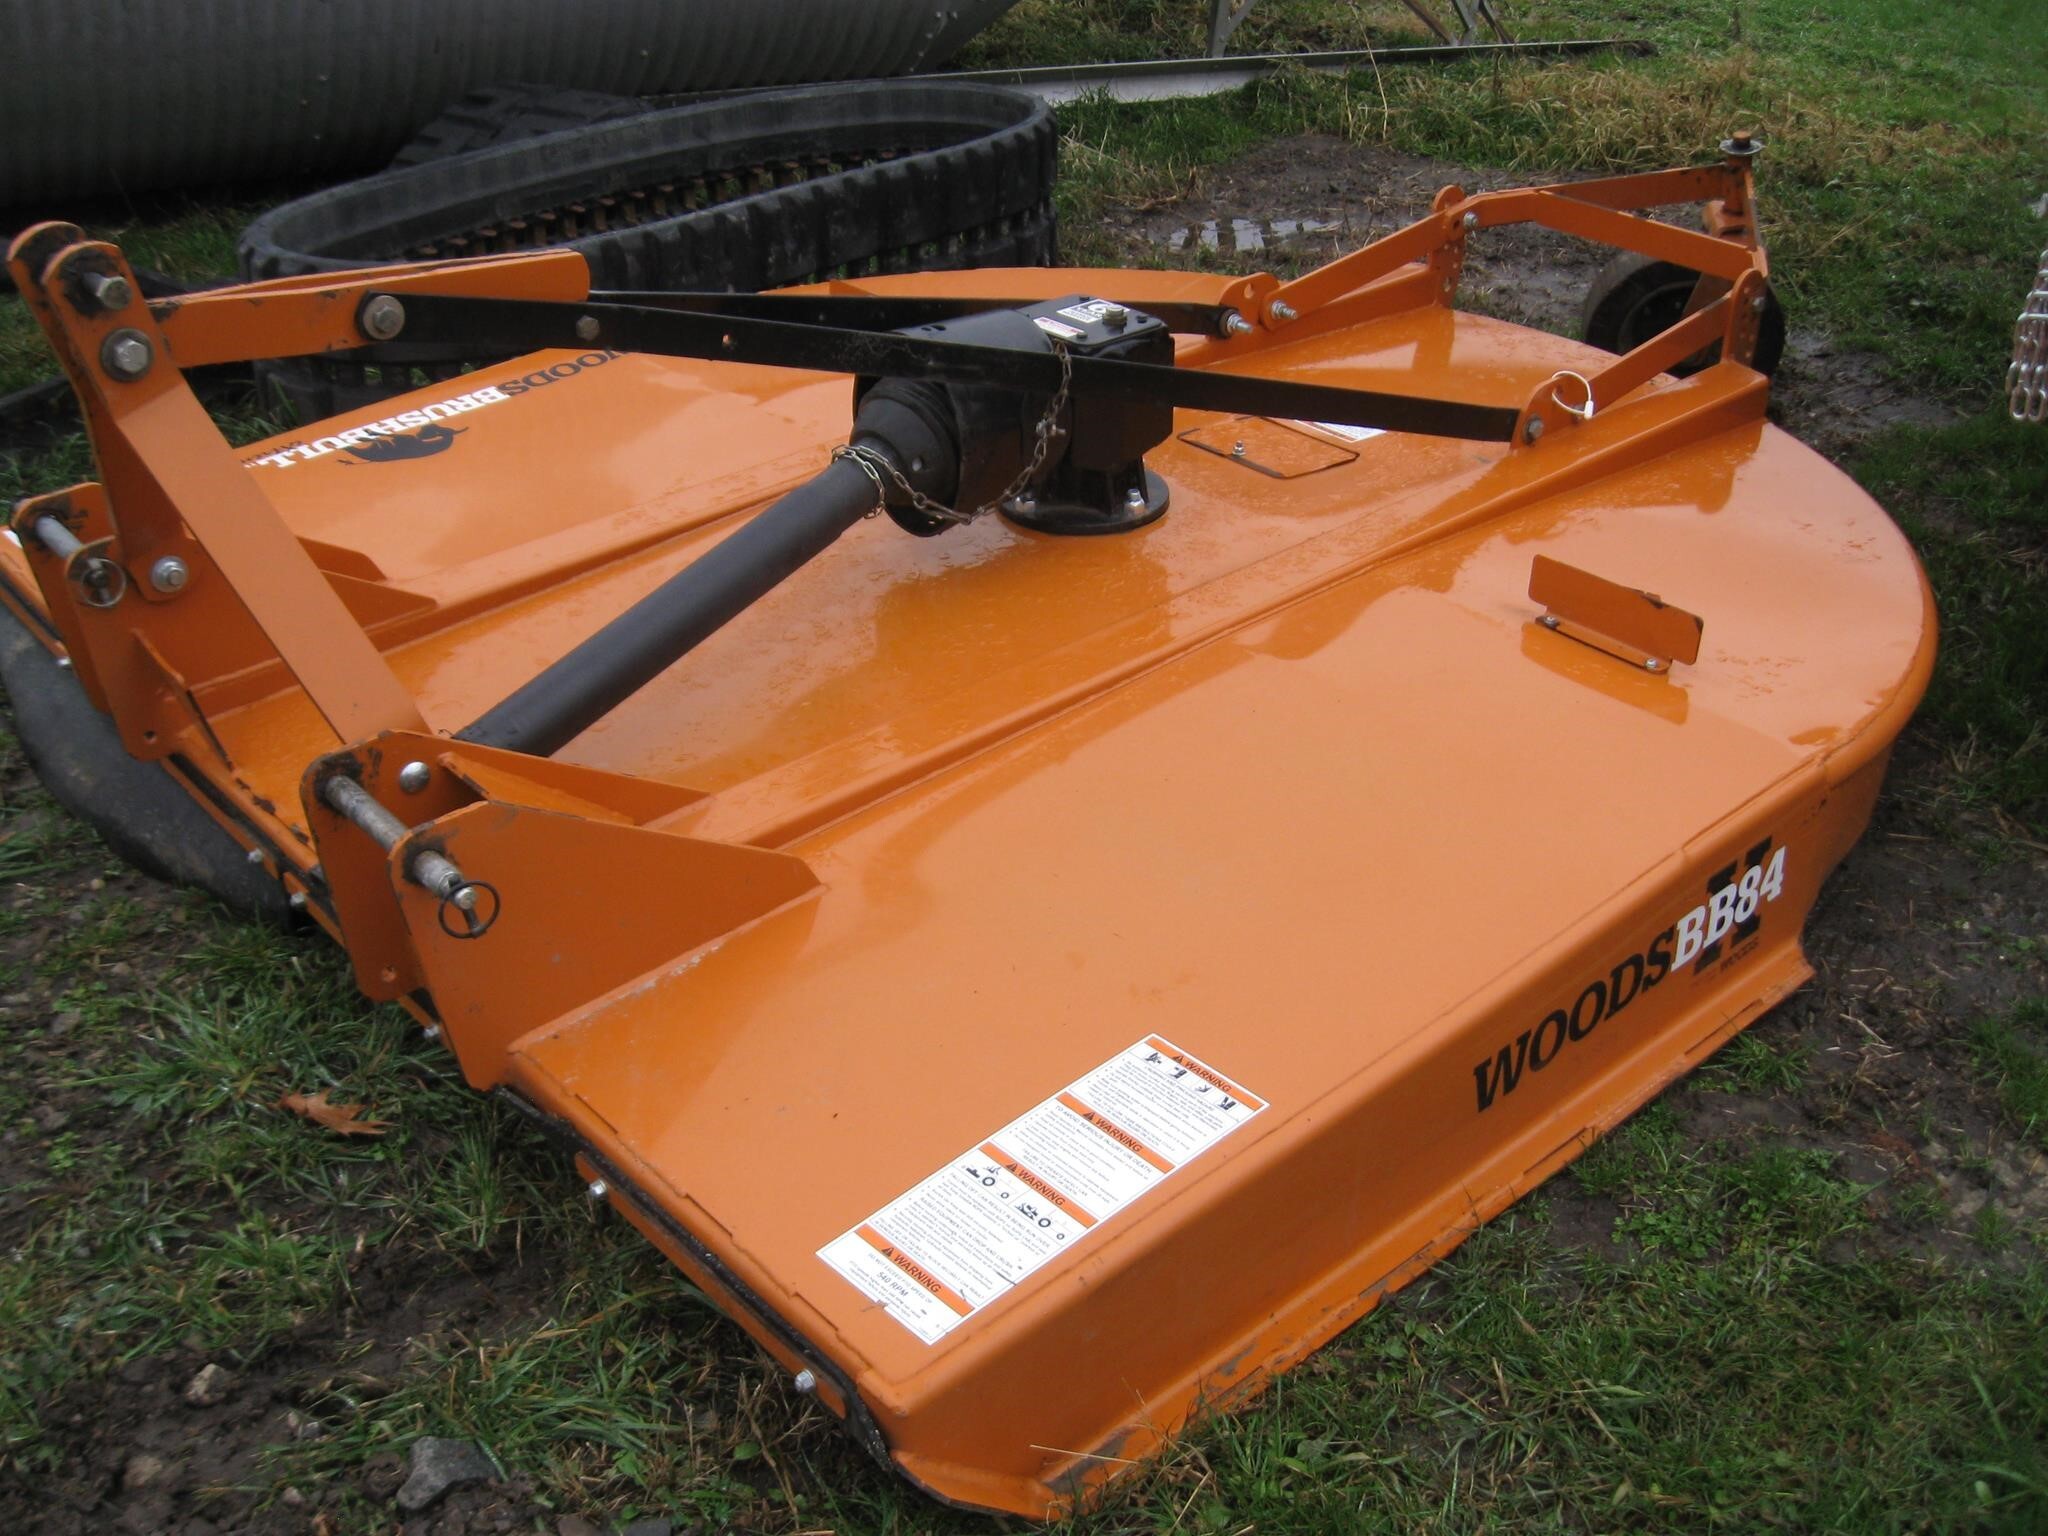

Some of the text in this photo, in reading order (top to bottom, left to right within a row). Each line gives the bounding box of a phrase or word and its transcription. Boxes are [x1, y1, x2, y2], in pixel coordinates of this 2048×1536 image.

[259, 385, 512, 469] BRUSHBULL
[1472, 845, 1786, 1113] WOODS BB84
[1183, 1060, 1233, 1093] WARNING
[1061, 1110, 1080, 1123] AVOID
[1077, 1121, 1104, 1140] SERIOUS
[1101, 1137, 1124, 1153] INJURY
[1121, 1151, 1133, 1160] OR
[1130, 1157, 1153, 1173] DEATH
[1093, 1117, 1144, 1153] WARNING
[1016, 1169, 1067, 1206] WARNING
[875, 1270, 910, 1297] 540 RPM
[892, 1253, 943, 1293] WARNING
